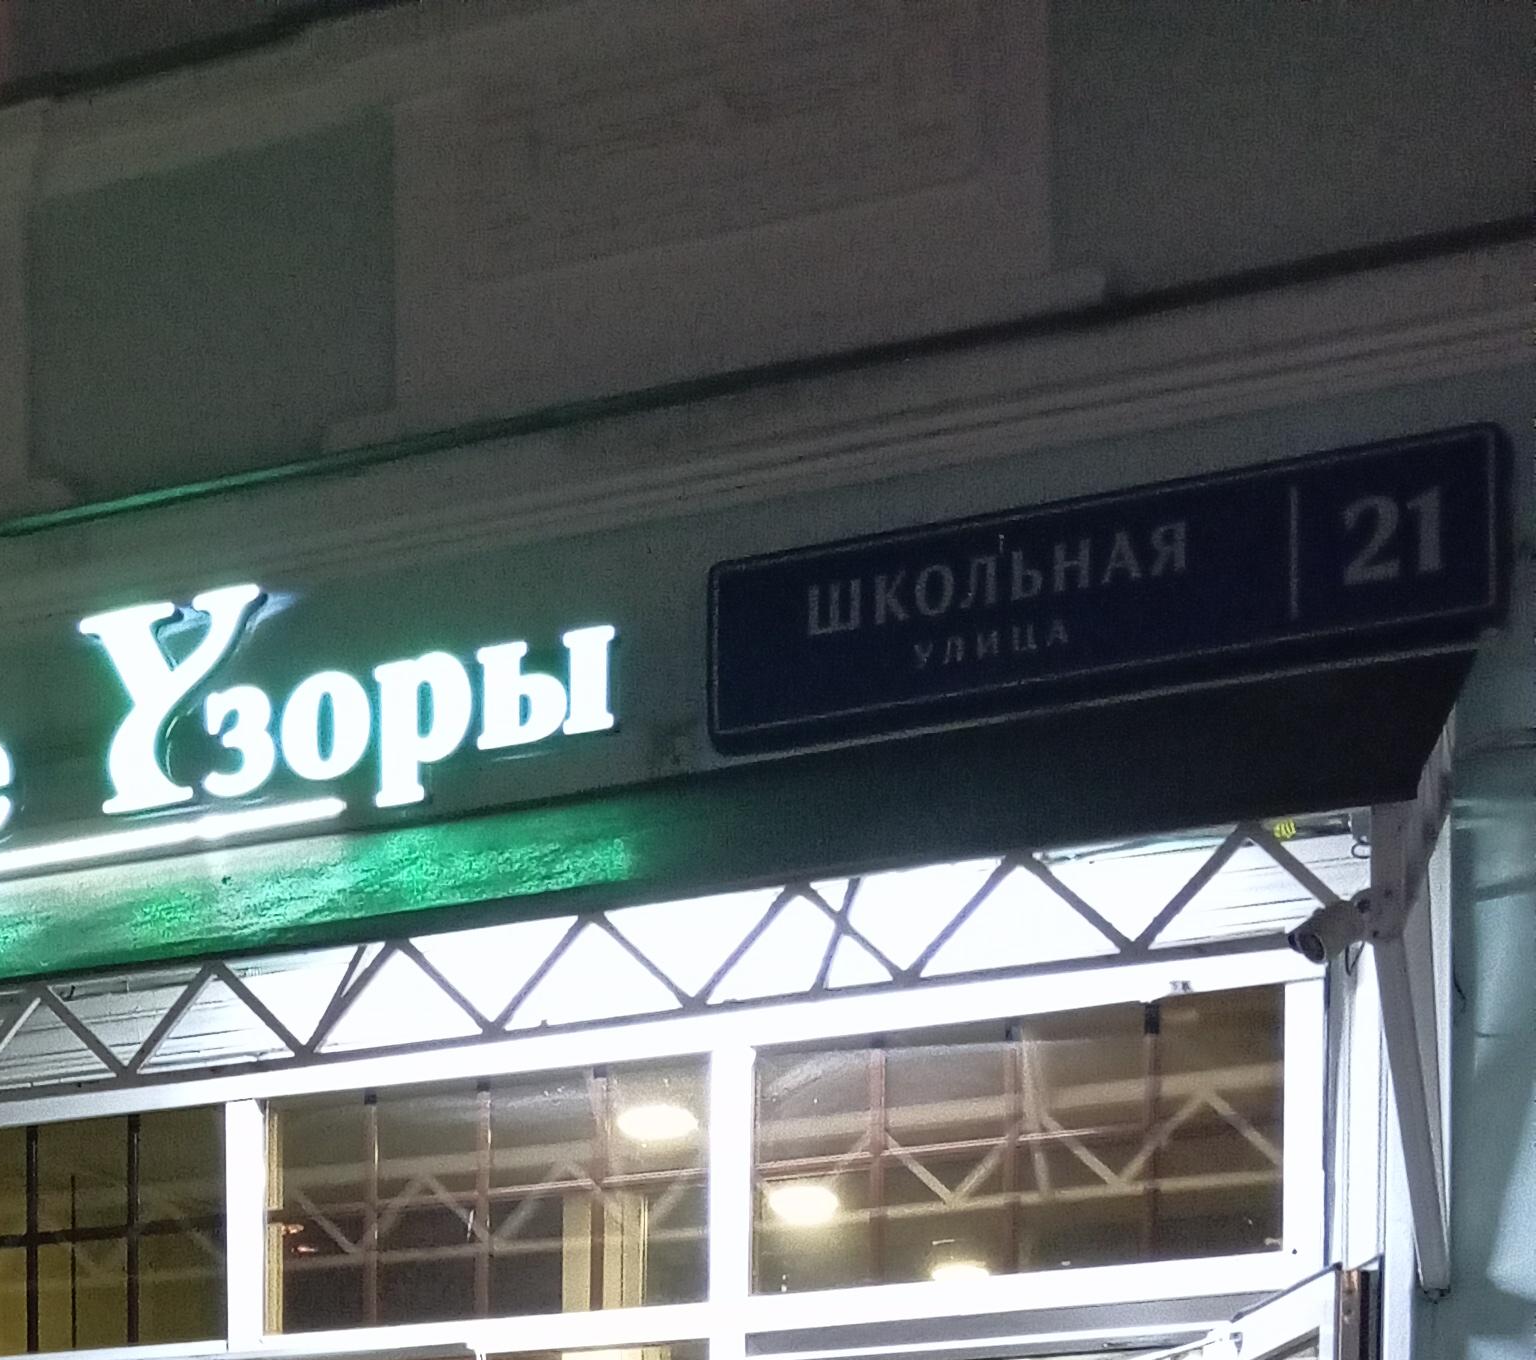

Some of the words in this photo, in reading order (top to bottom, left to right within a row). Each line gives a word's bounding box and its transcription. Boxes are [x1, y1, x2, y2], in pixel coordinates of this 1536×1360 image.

[805, 520, 1190, 637] ШКОЛЬНАЯ
[1340, 485, 1445, 587] 21
[78, 583, 616, 813] Узоры
[913, 619, 1071, 669] УЛИЦА
